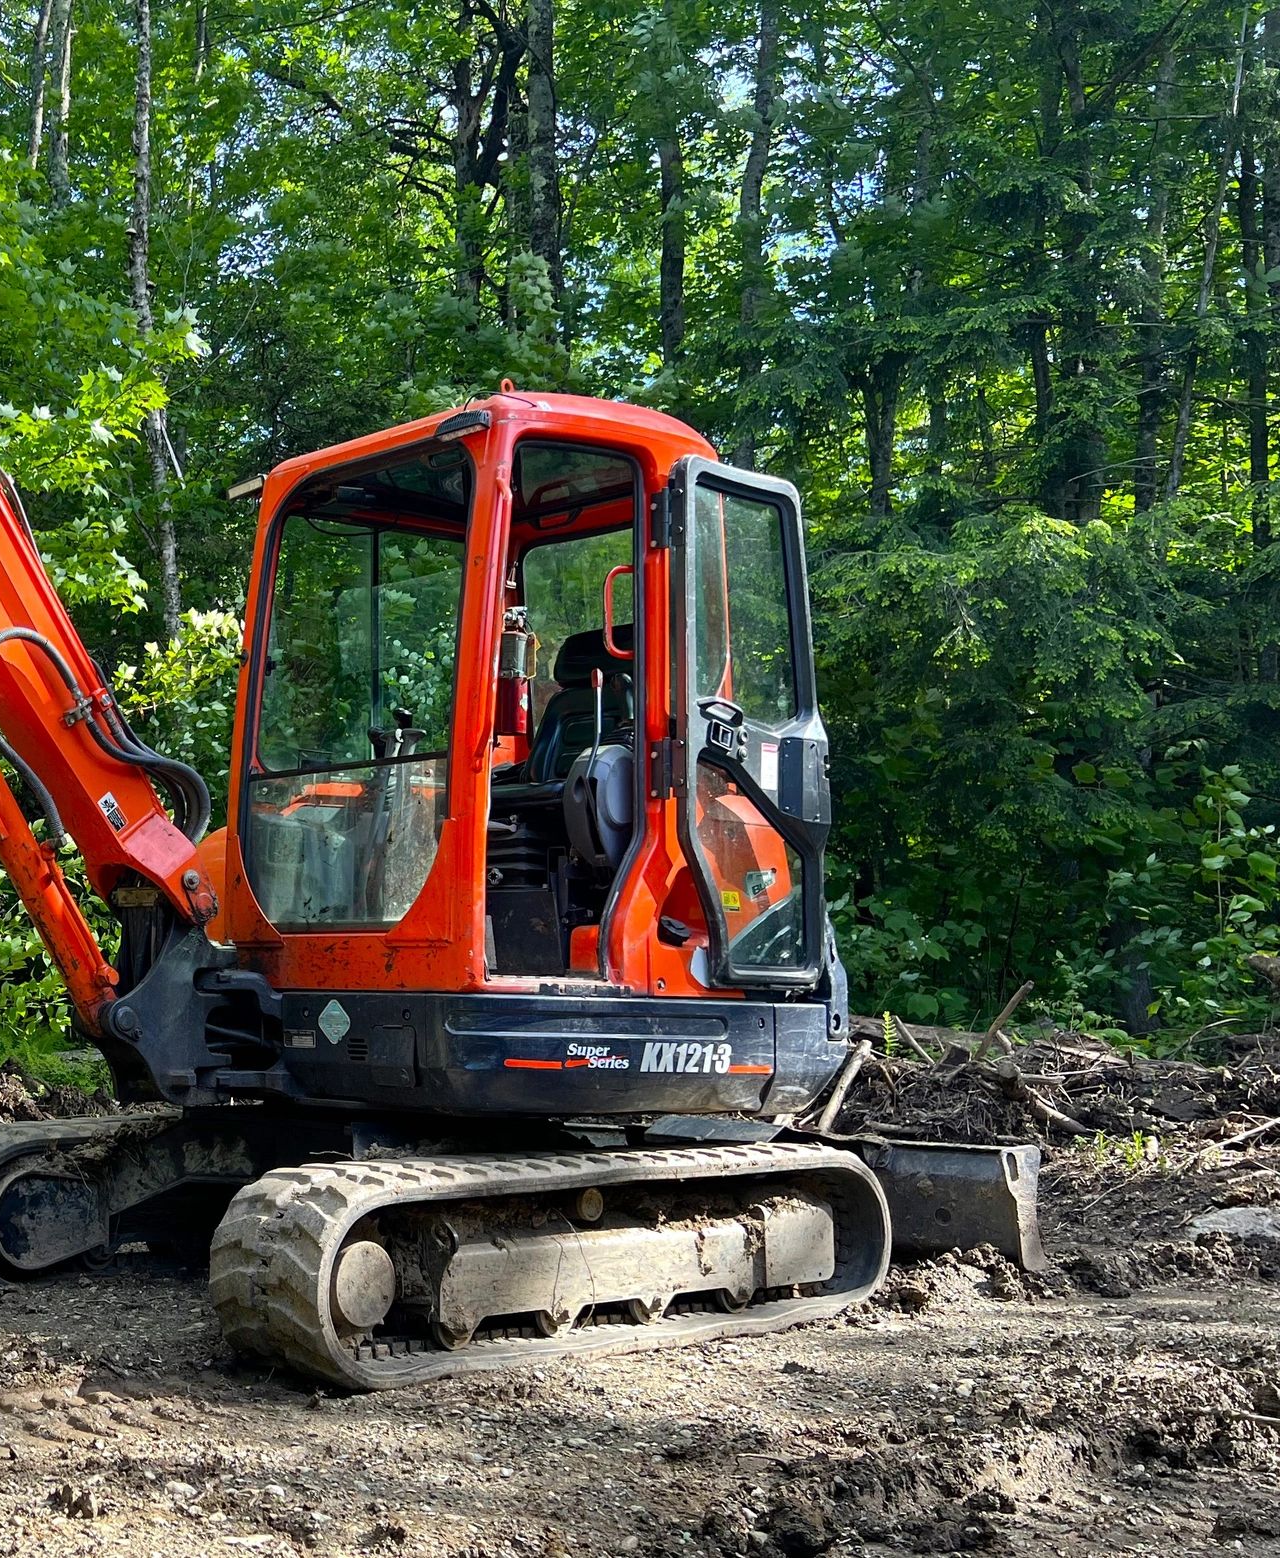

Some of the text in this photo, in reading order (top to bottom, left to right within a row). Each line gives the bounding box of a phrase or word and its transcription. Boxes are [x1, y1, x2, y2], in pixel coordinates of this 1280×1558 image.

[567, 1043, 611, 1060] Super
[640, 1042, 732, 1073] KX121-3
[587, 1055, 630, 1069] Series
